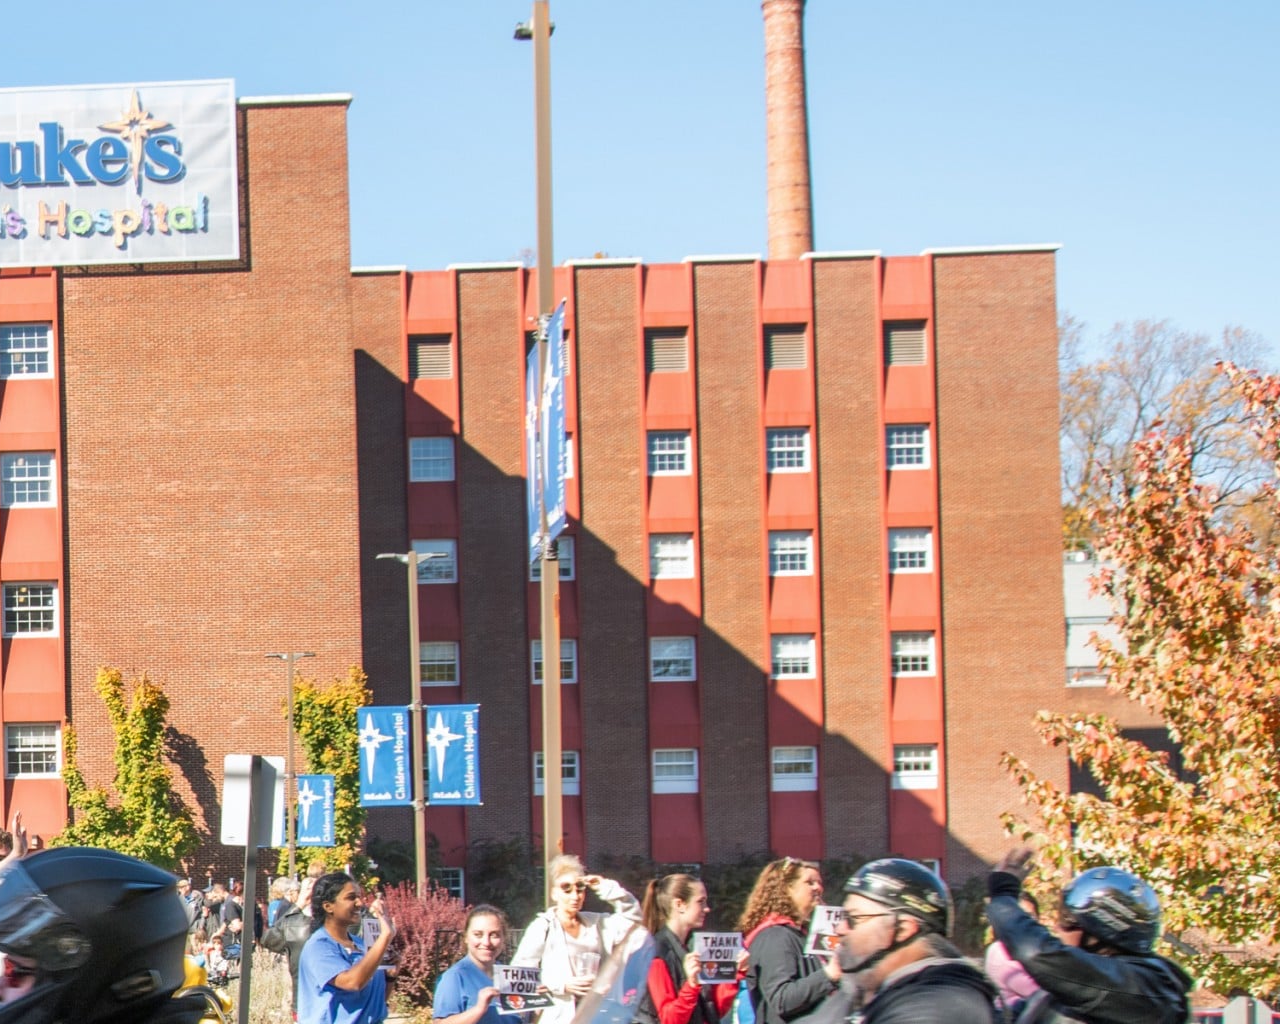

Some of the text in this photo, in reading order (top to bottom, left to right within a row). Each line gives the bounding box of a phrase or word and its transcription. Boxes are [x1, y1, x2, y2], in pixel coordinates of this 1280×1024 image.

[38, 192, 210, 249] Hospital
[392, 712, 407, 753] Hospital
[462, 711, 477, 752] Hospital
[703, 937, 738, 947] THANK
[708, 948, 733, 959] YOU!
[503, 969, 539, 981] THANK
